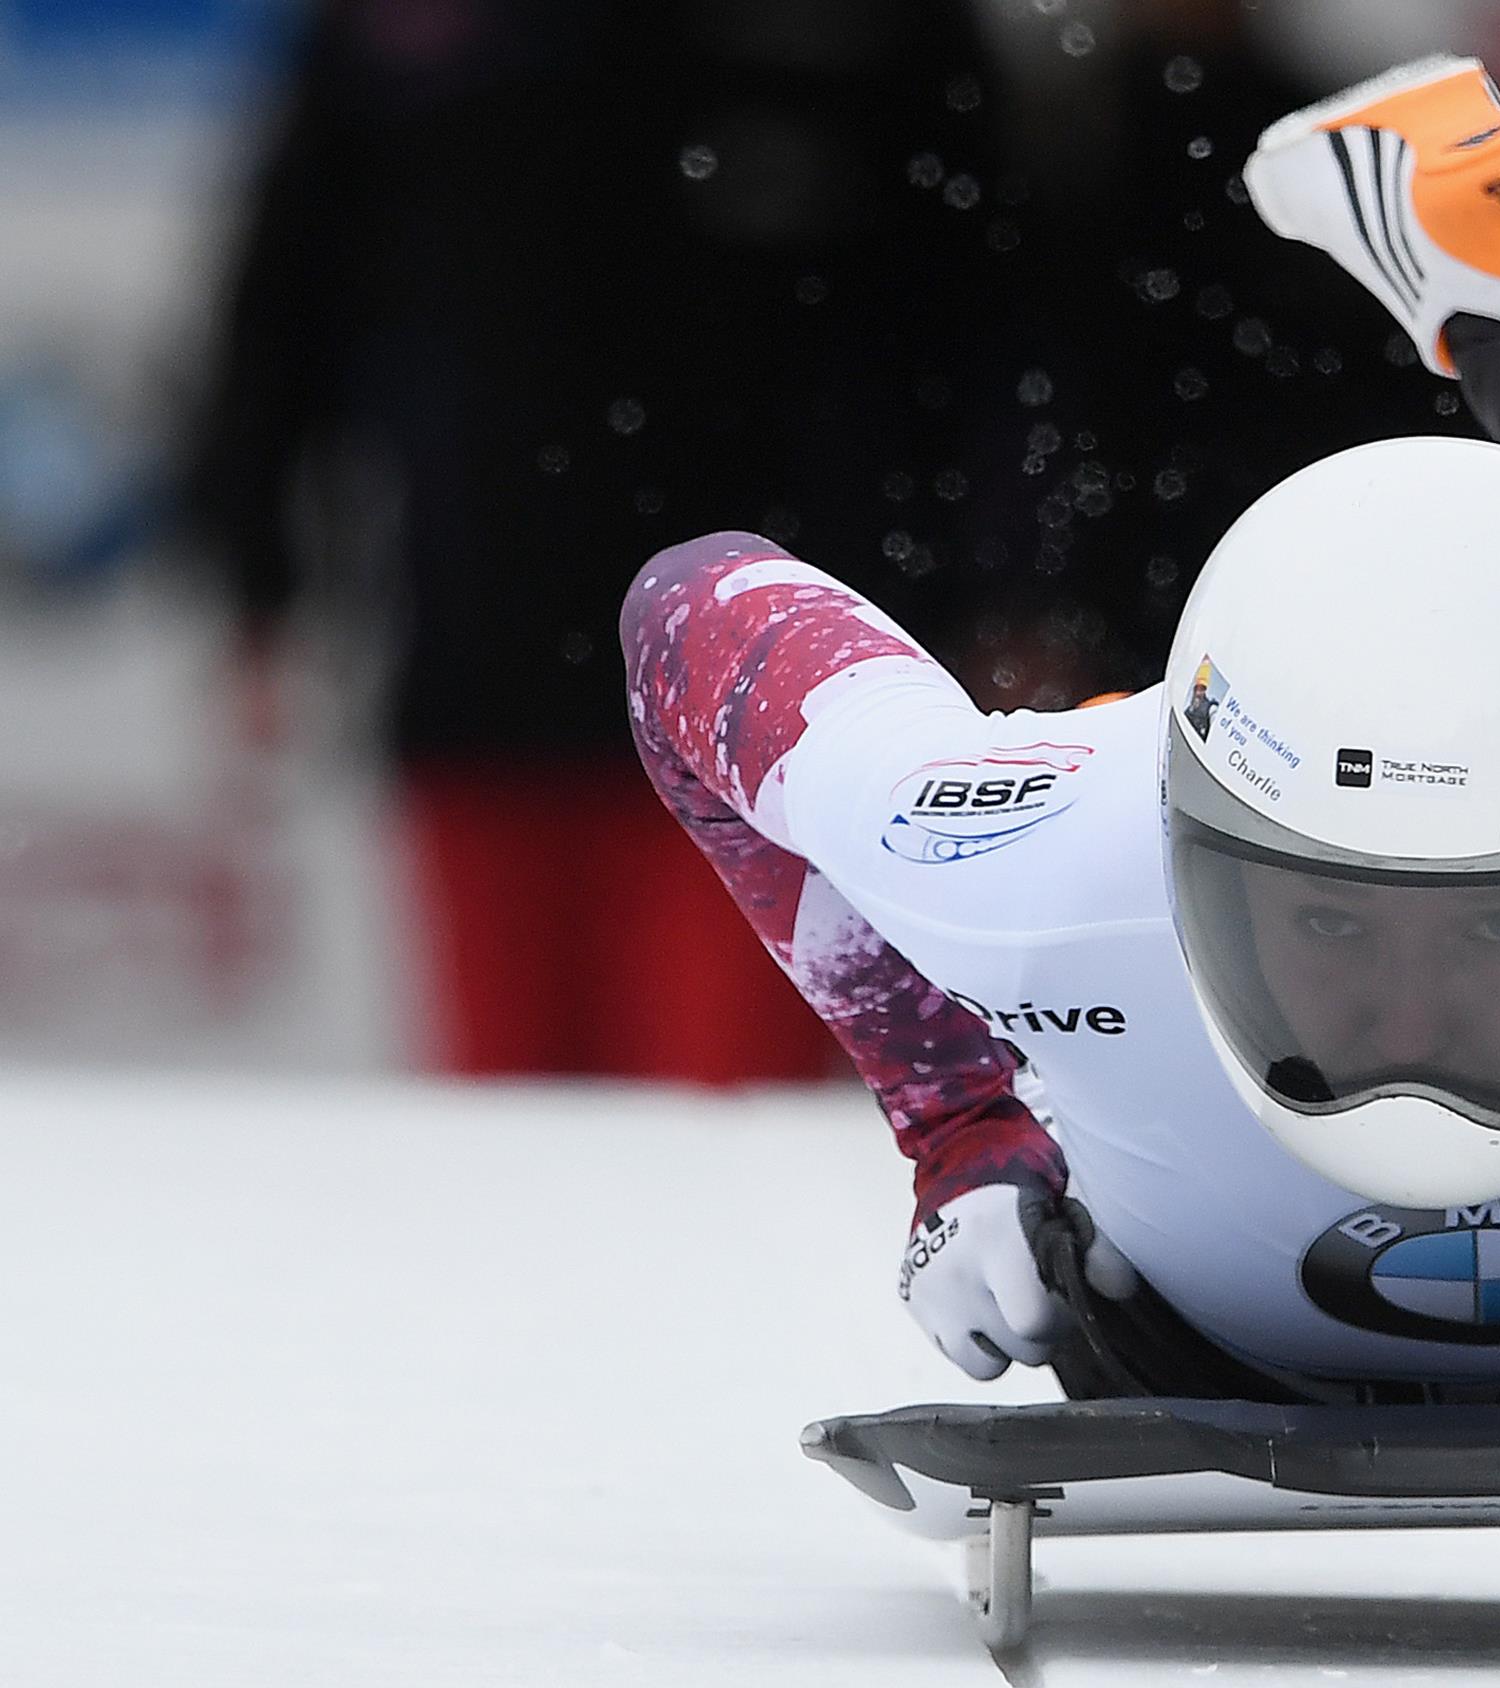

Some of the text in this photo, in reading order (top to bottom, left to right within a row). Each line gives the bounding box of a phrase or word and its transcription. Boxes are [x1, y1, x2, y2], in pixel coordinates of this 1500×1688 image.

[1219, 717, 1248, 747] of you
[1225, 696, 1302, 769] We are thinking
[1228, 749, 1282, 802] Charlie
[1339, 761, 1370, 774] TNM
[1381, 773, 1467, 787] MORTGAGE
[914, 773, 1058, 809] IBSF
